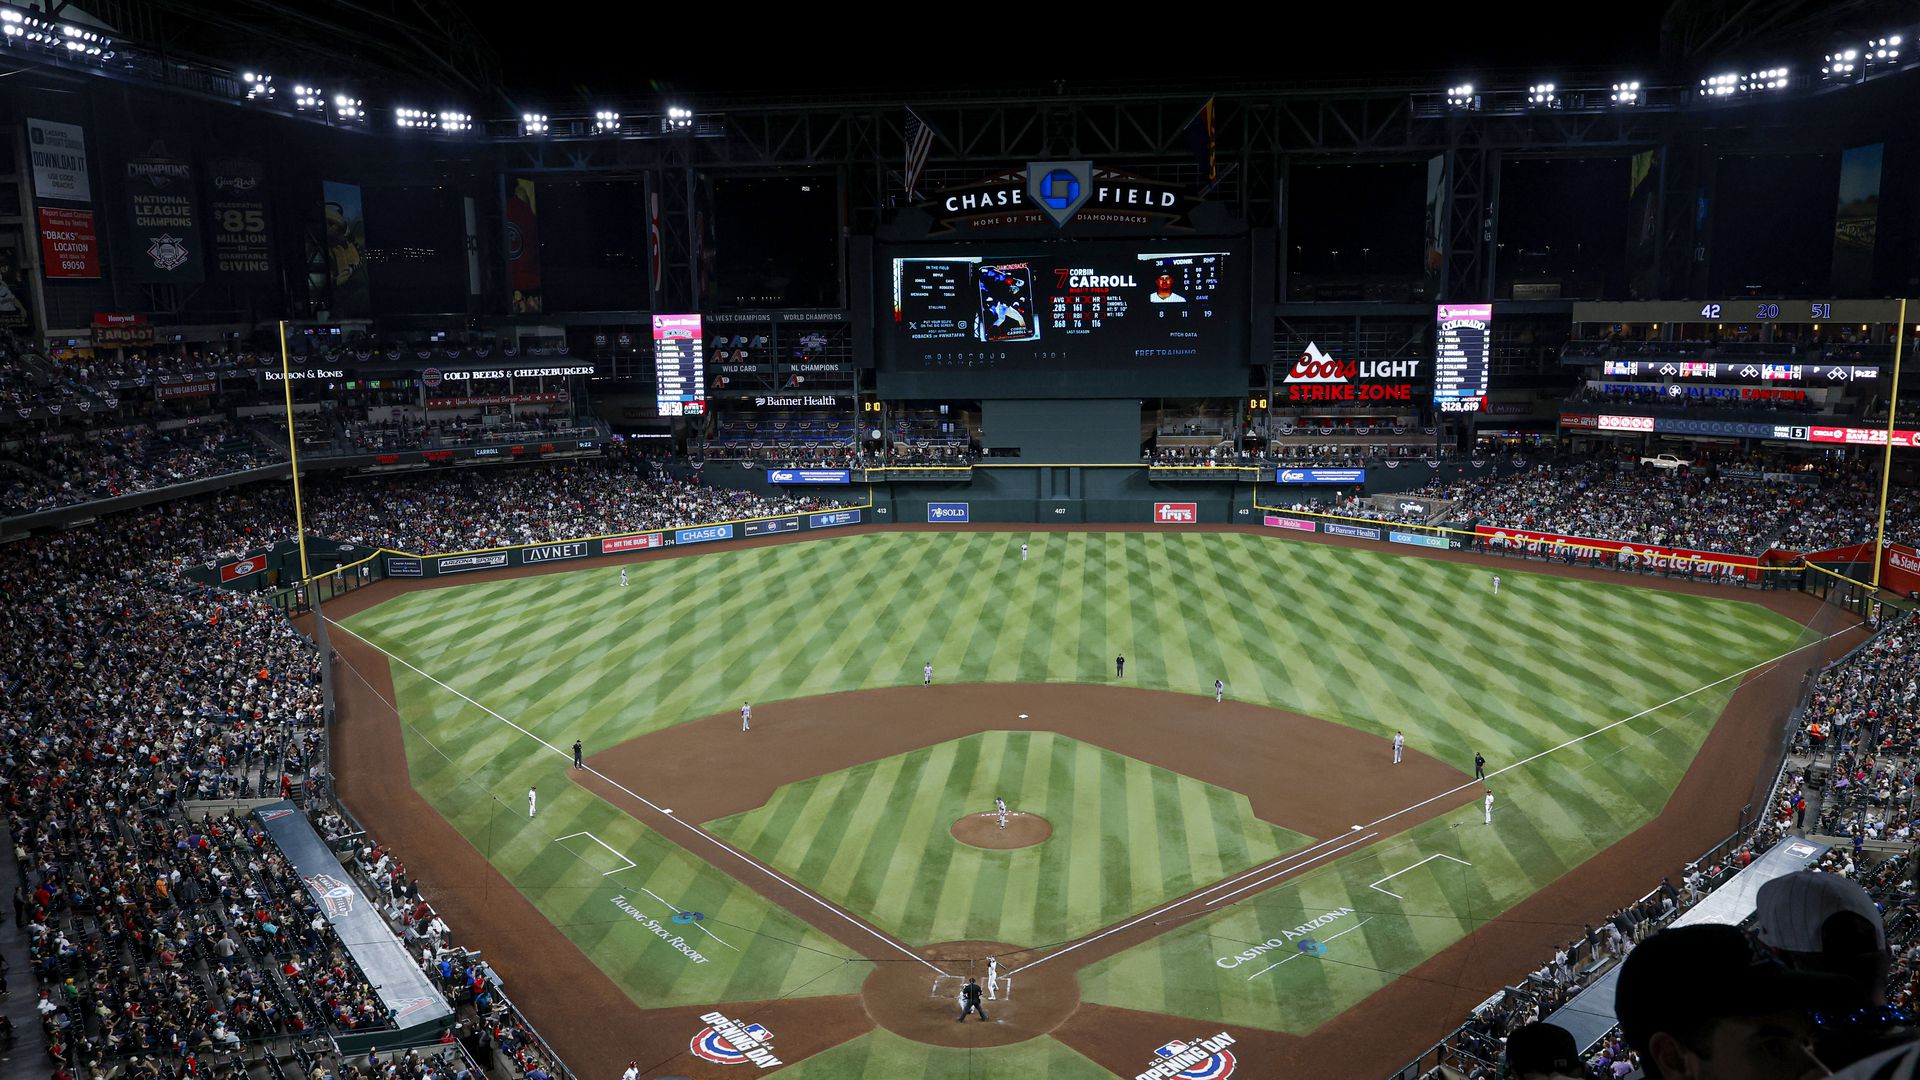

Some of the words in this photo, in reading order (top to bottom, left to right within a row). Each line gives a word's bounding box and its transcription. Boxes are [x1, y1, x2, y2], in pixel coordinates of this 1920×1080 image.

[34, 151, 76, 171] DOWNLOAD
[78, 157, 84, 172] IT
[128, 163, 190, 178] CHAMPIONS
[134, 195, 190, 204] NATIONAL
[946, 189, 1022, 212] CHASE
[1099, 188, 1176, 207] FIELD
[136, 205, 192, 216] LEAGUE
[136, 217, 192, 227] CHAMPIONS
[214, 209, 265, 232] $85
[974, 218, 1000, 227] HOME
[1077, 214, 1148, 223] DIAMONDBACKS
[216, 234, 267, 244] MILLION
[54, 242, 88, 252] LOCATION
[62, 260, 85, 270] 69050
[219, 260, 270, 272] GIVING
[1070, 276, 1137, 288] CARROLL
[1702, 304, 1720, 318] 42
[1756, 304, 1780, 318] 20
[1811, 304, 1832, 318] 51
[1052, 320, 1066, 328] .868
[1442, 320, 1486, 330] COLORADO
[1290, 352, 1358, 379] Coors
[1360, 360, 1420, 378] LIGHT
[307, 370, 316, 379] &
[317, 369, 344, 378] BONES
[444, 372, 470, 380] COLD
[472, 370, 504, 380] BEERS
[506, 370, 512, 378] &
[514, 366, 594, 378] CHEESEBURGERS
[1288, 384, 1354, 400] STRIKE
[1358, 384, 1412, 400] ZONE
[1684, 386, 1740, 398] JALISCO
[1742, 388, 1805, 400] CANTINA
[767, 396, 802, 406] Banner
[804, 396, 836, 406] Health
[1442, 402, 1479, 412] $128,619
[1796, 428, 1802, 437] 5
[1158, 504, 1192, 520] fry's
[682, 530, 716, 541] CHASE
[1336, 526, 1354, 535] Banner
[1356, 528, 1376, 538] Health
[530, 544, 580, 561] AVNET
[610, 894, 648, 923] TALKING
[642, 919, 670, 940] STICK
[668, 936, 710, 965] RESORT
[1216, 938, 1282, 970] CASINO
[1282, 906, 1355, 941] ARIZONA
[700, 1011, 758, 1052] OPENING
[744, 1045, 783, 1069] DAY
[1135, 1046, 1208, 1080] OPENING
[1204, 1031, 1236, 1055] DAY
[1148, 1058, 1164, 1067] 20
